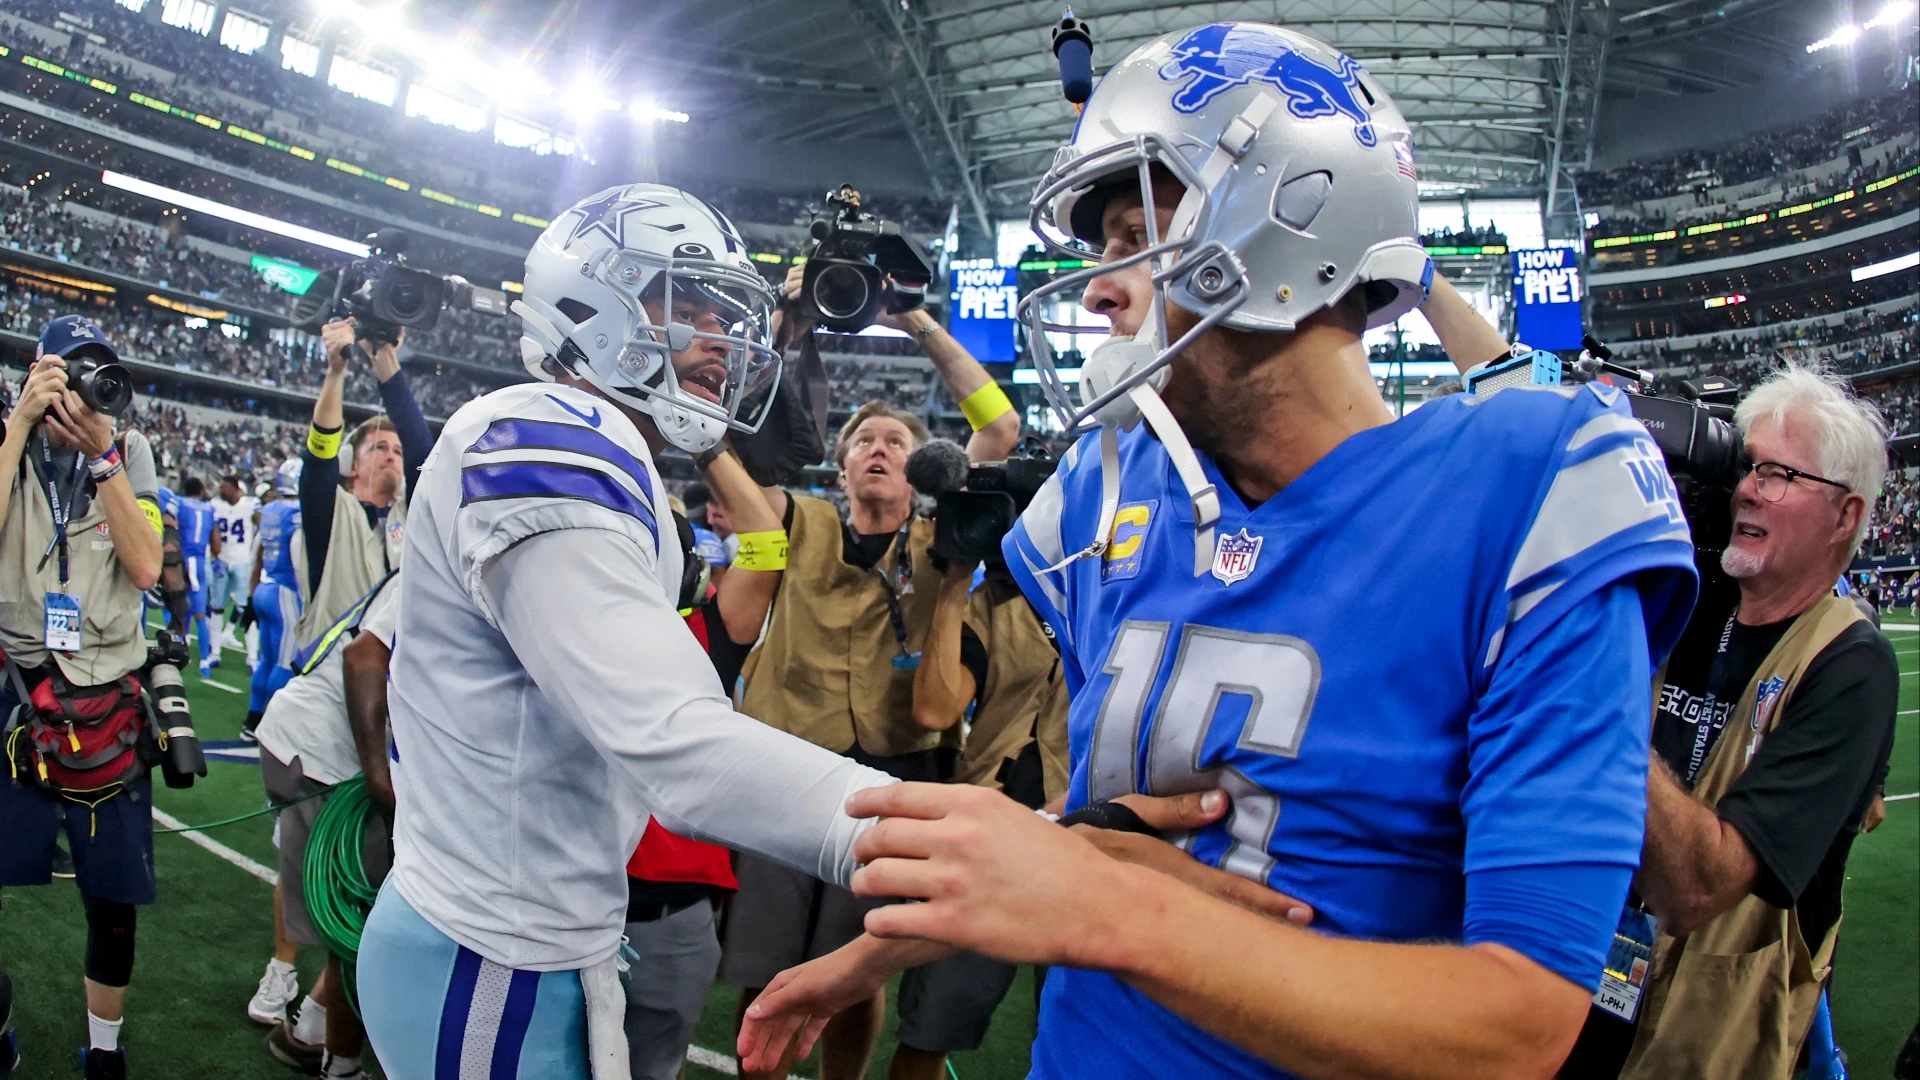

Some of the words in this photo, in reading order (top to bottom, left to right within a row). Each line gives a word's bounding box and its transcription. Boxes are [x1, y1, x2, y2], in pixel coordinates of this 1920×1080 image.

[1518, 250, 1564, 269] HOW
[957, 269, 1006, 287] HOW
[195, 510, 203, 543] 1
[219, 517, 245, 543] 24
[1104, 505, 1150, 562] C
[1221, 553, 1247, 574] NFL
[1700, 692, 1716, 723] AT&T
[1088, 619, 1322, 886] 16
